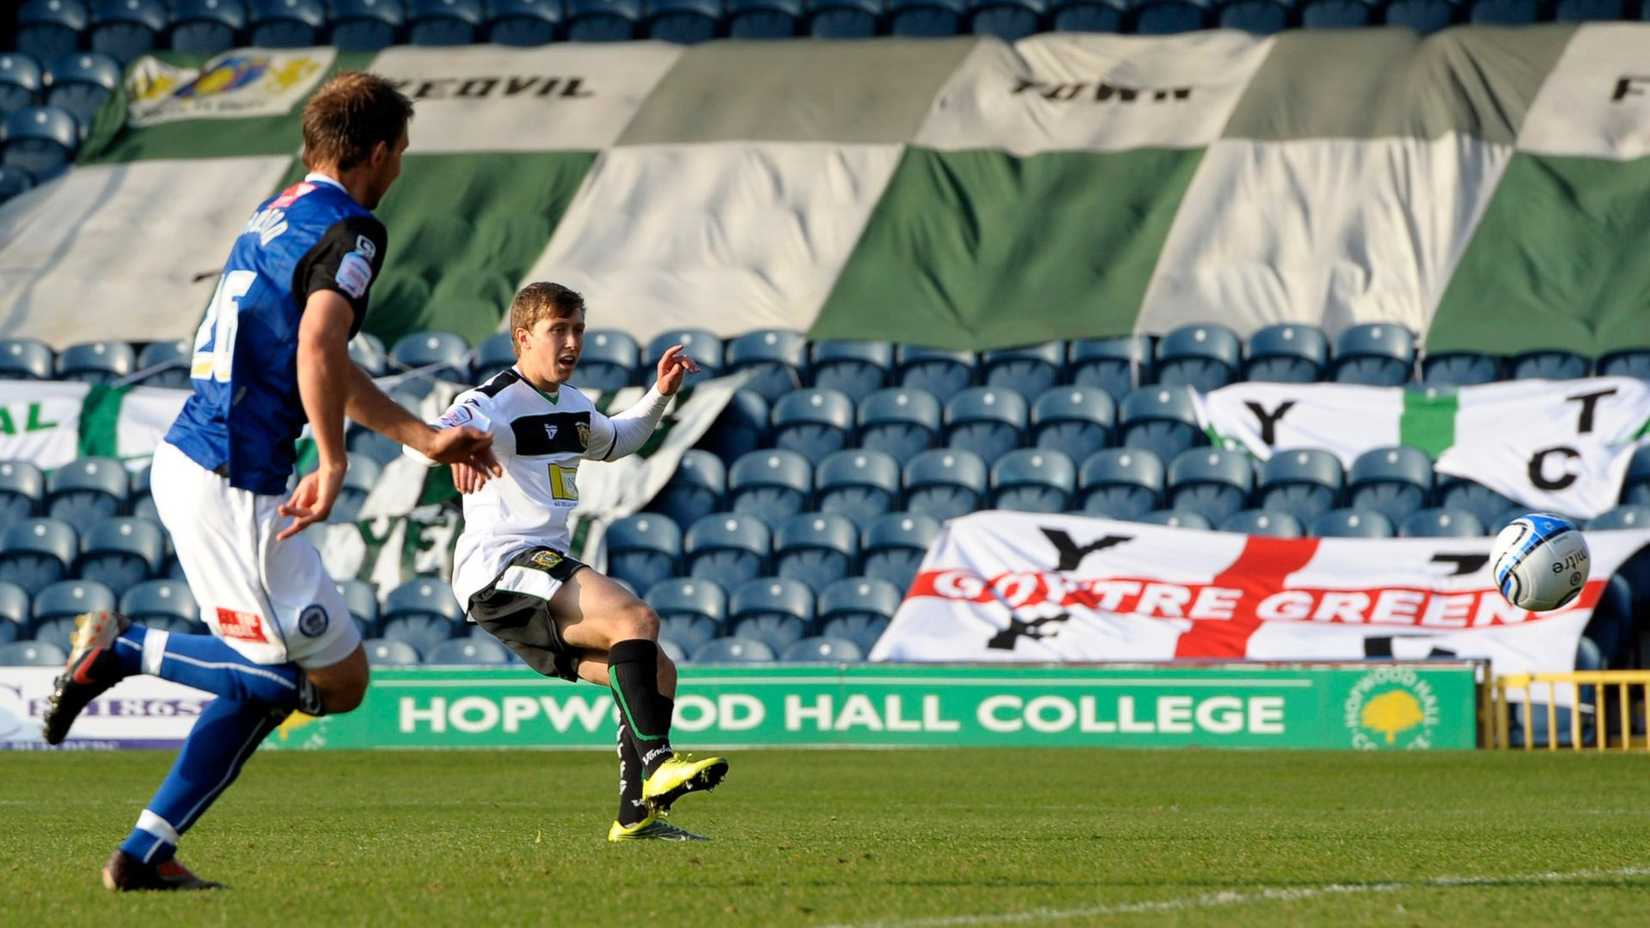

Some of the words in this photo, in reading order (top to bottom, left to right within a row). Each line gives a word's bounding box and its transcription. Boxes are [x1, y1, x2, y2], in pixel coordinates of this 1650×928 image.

[190, 271, 258, 384] 26
[1245, 401, 1296, 446] Y
[1566, 388, 1617, 434] T
[1527, 447, 1583, 491] C
[1038, 526, 1134, 572] Y
[400, 694, 765, 733] HOPWOD
[785, 694, 960, 732] HALL
[976, 694, 1286, 733] COLLEGE
